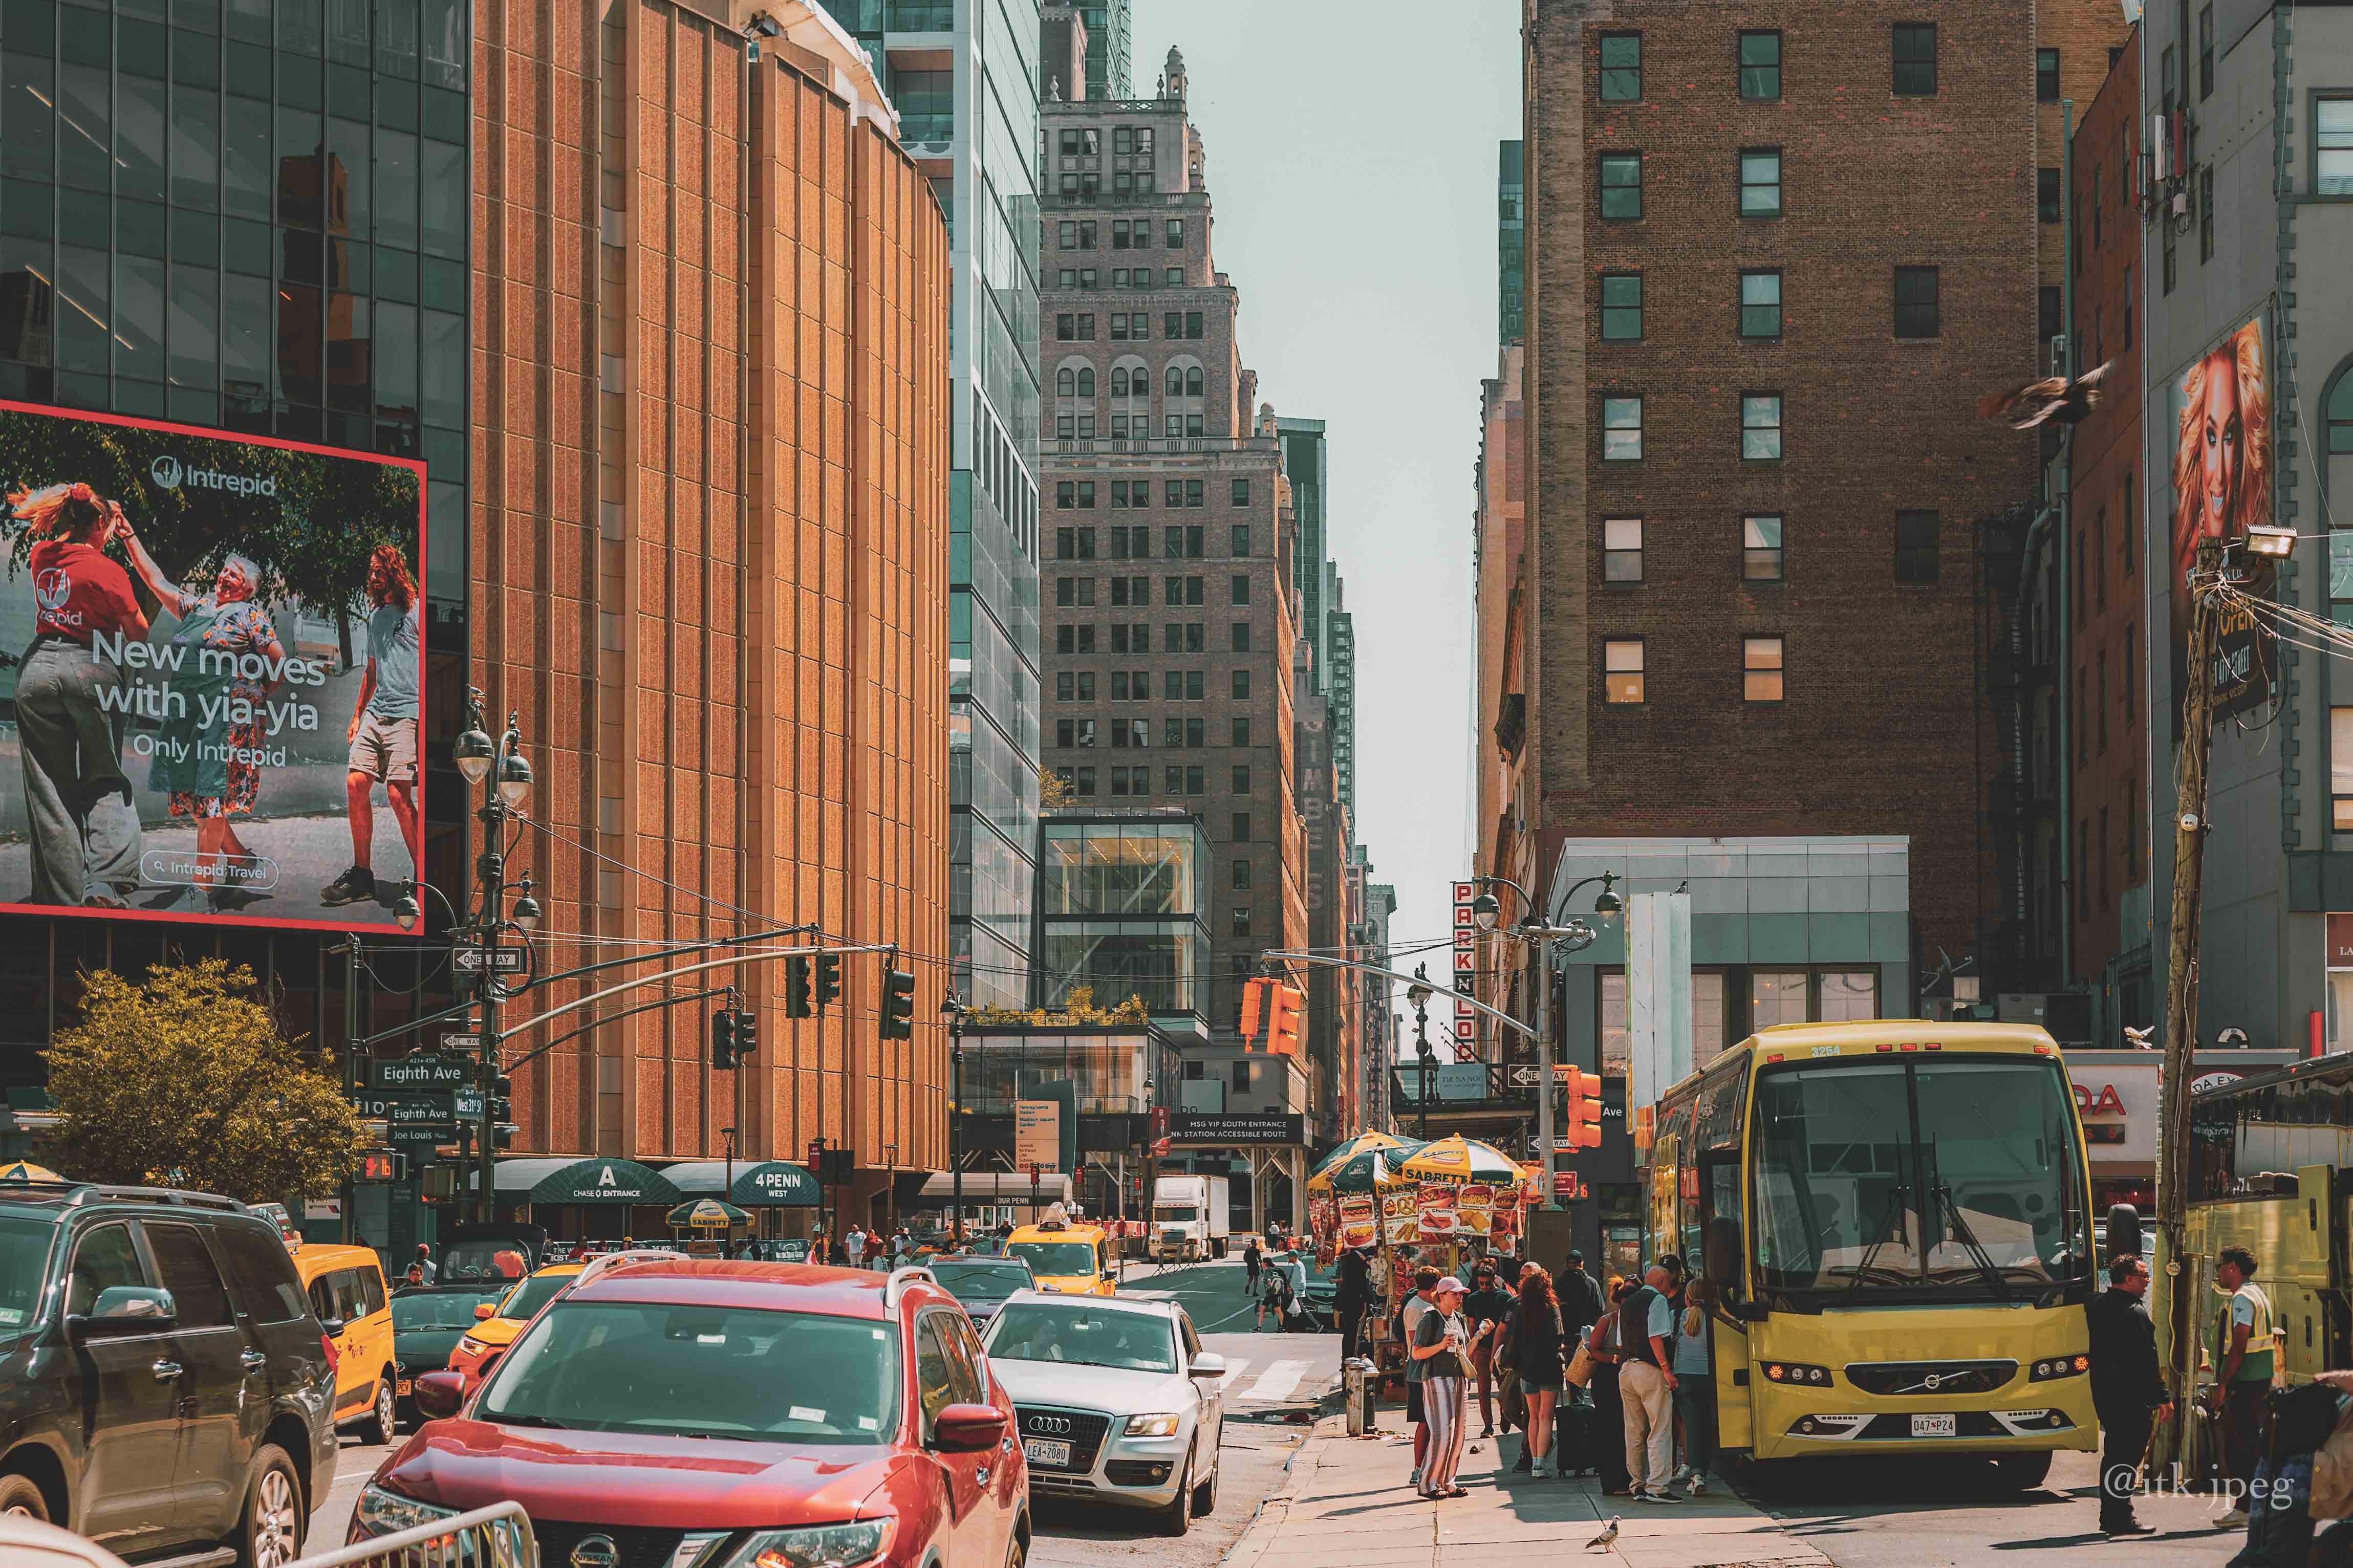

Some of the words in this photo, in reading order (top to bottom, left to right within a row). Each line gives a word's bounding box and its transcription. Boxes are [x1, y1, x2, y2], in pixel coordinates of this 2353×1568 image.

[187, 464, 275, 498] Intrepid
[40, 611, 82, 627] repid
[92, 629, 187, 673] New
[199, 647, 328, 687] moves
[94, 678, 186, 719] with
[196, 686, 319, 737] yia-yia
[133, 734, 190, 765] Only
[197, 743, 287, 769] Intrepid
[170, 860, 224, 879] Intrepid
[227, 864, 266, 880] Travel
[464, 955, 482, 964] ONE
[495, 955, 510, 964] AY
[1812, 1046, 1840, 1056] 3254
[384, 1065, 428, 1083] Eighth
[434, 1066, 461, 1080] Ave
[1519, 1072, 1537, 1080] ONE
[1553, 1072, 1565, 1080] AY
[457, 1098, 468, 1112] West
[477, 1100, 482, 1113] St
[1603, 1107, 1622, 1117] Ave
[394, 1109, 426, 1120] Eighth
[428, 1109, 447, 1119] Ave
[394, 1131, 408, 1140] Joe
[411, 1130, 432, 1140] Louis
[598, 1166, 616, 1186] A
[755, 1174, 765, 1187] 4
[766, 1173, 801, 1188] PENN
[1406, 1168, 1468, 1184] SABRETT
[768, 1189, 788, 1197] WEST
[1914, 1421, 1930, 1431] 047
[1936, 1420, 1953, 1431] P24
[1027, 1445, 1041, 1457] LEA
[1047, 1447, 1066, 1460] 2080
[572, 1554, 614, 1565] NISSAN
